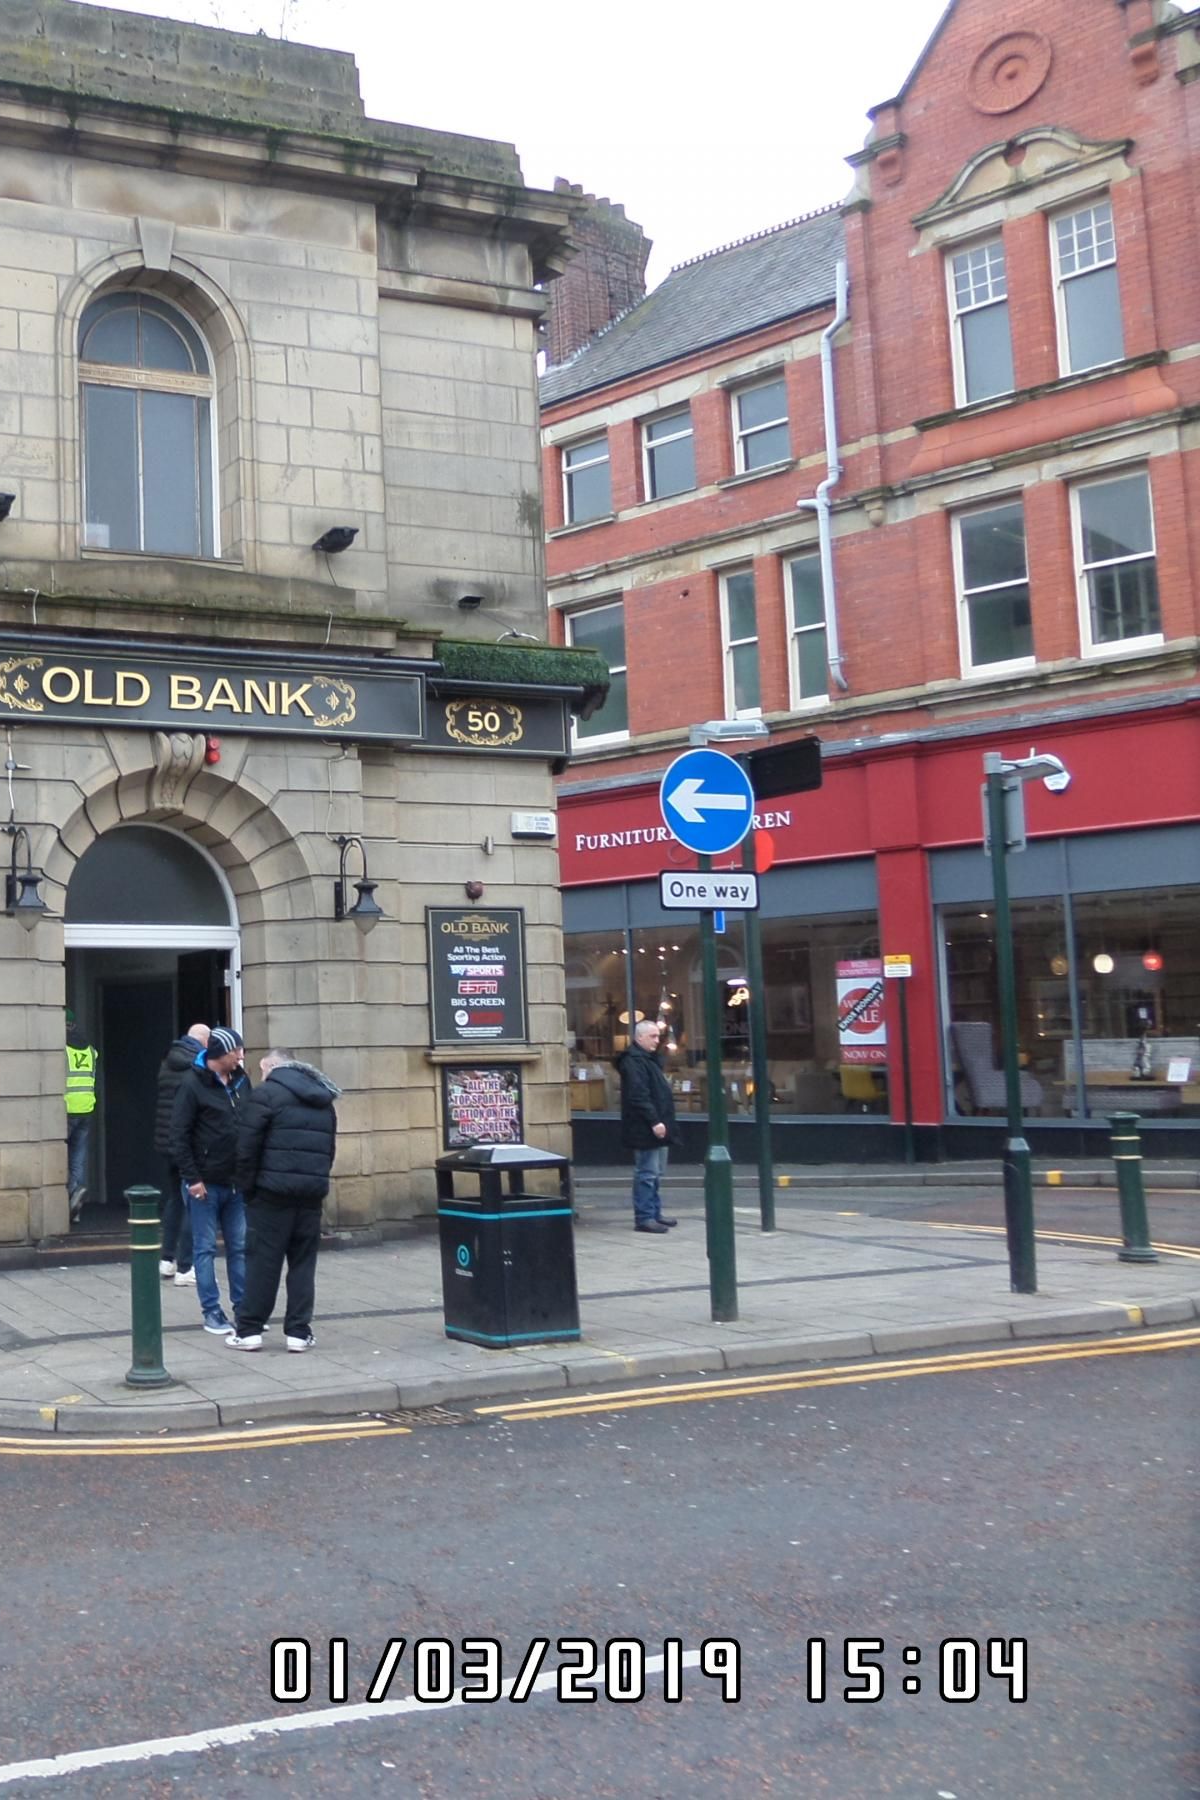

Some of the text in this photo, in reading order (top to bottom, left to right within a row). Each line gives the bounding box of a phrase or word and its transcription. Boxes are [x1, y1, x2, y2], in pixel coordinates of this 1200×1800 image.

[41, 666, 316, 717] OLD BANK
[467, 711, 501, 732] 50
[752, 810, 791, 829] REN
[669, 881, 750, 902] One way
[440, 922, 510, 933] OLD BANK
[481, 946, 500, 954] Best
[447, 954, 480, 962] Sporting
[466, 966, 505, 976] SPORTS
[450, 998, 506, 1006] BIG SCREEN
[844, 1049, 887, 1059] NOW ON
[468, 1080, 500, 1091] ALL THE
[454, 1094, 514, 1105] TOP SPORTING
[453, 1108, 516, 1119] ACTION ON THE
[461, 1122, 509, 1133] BIG SCREEN
